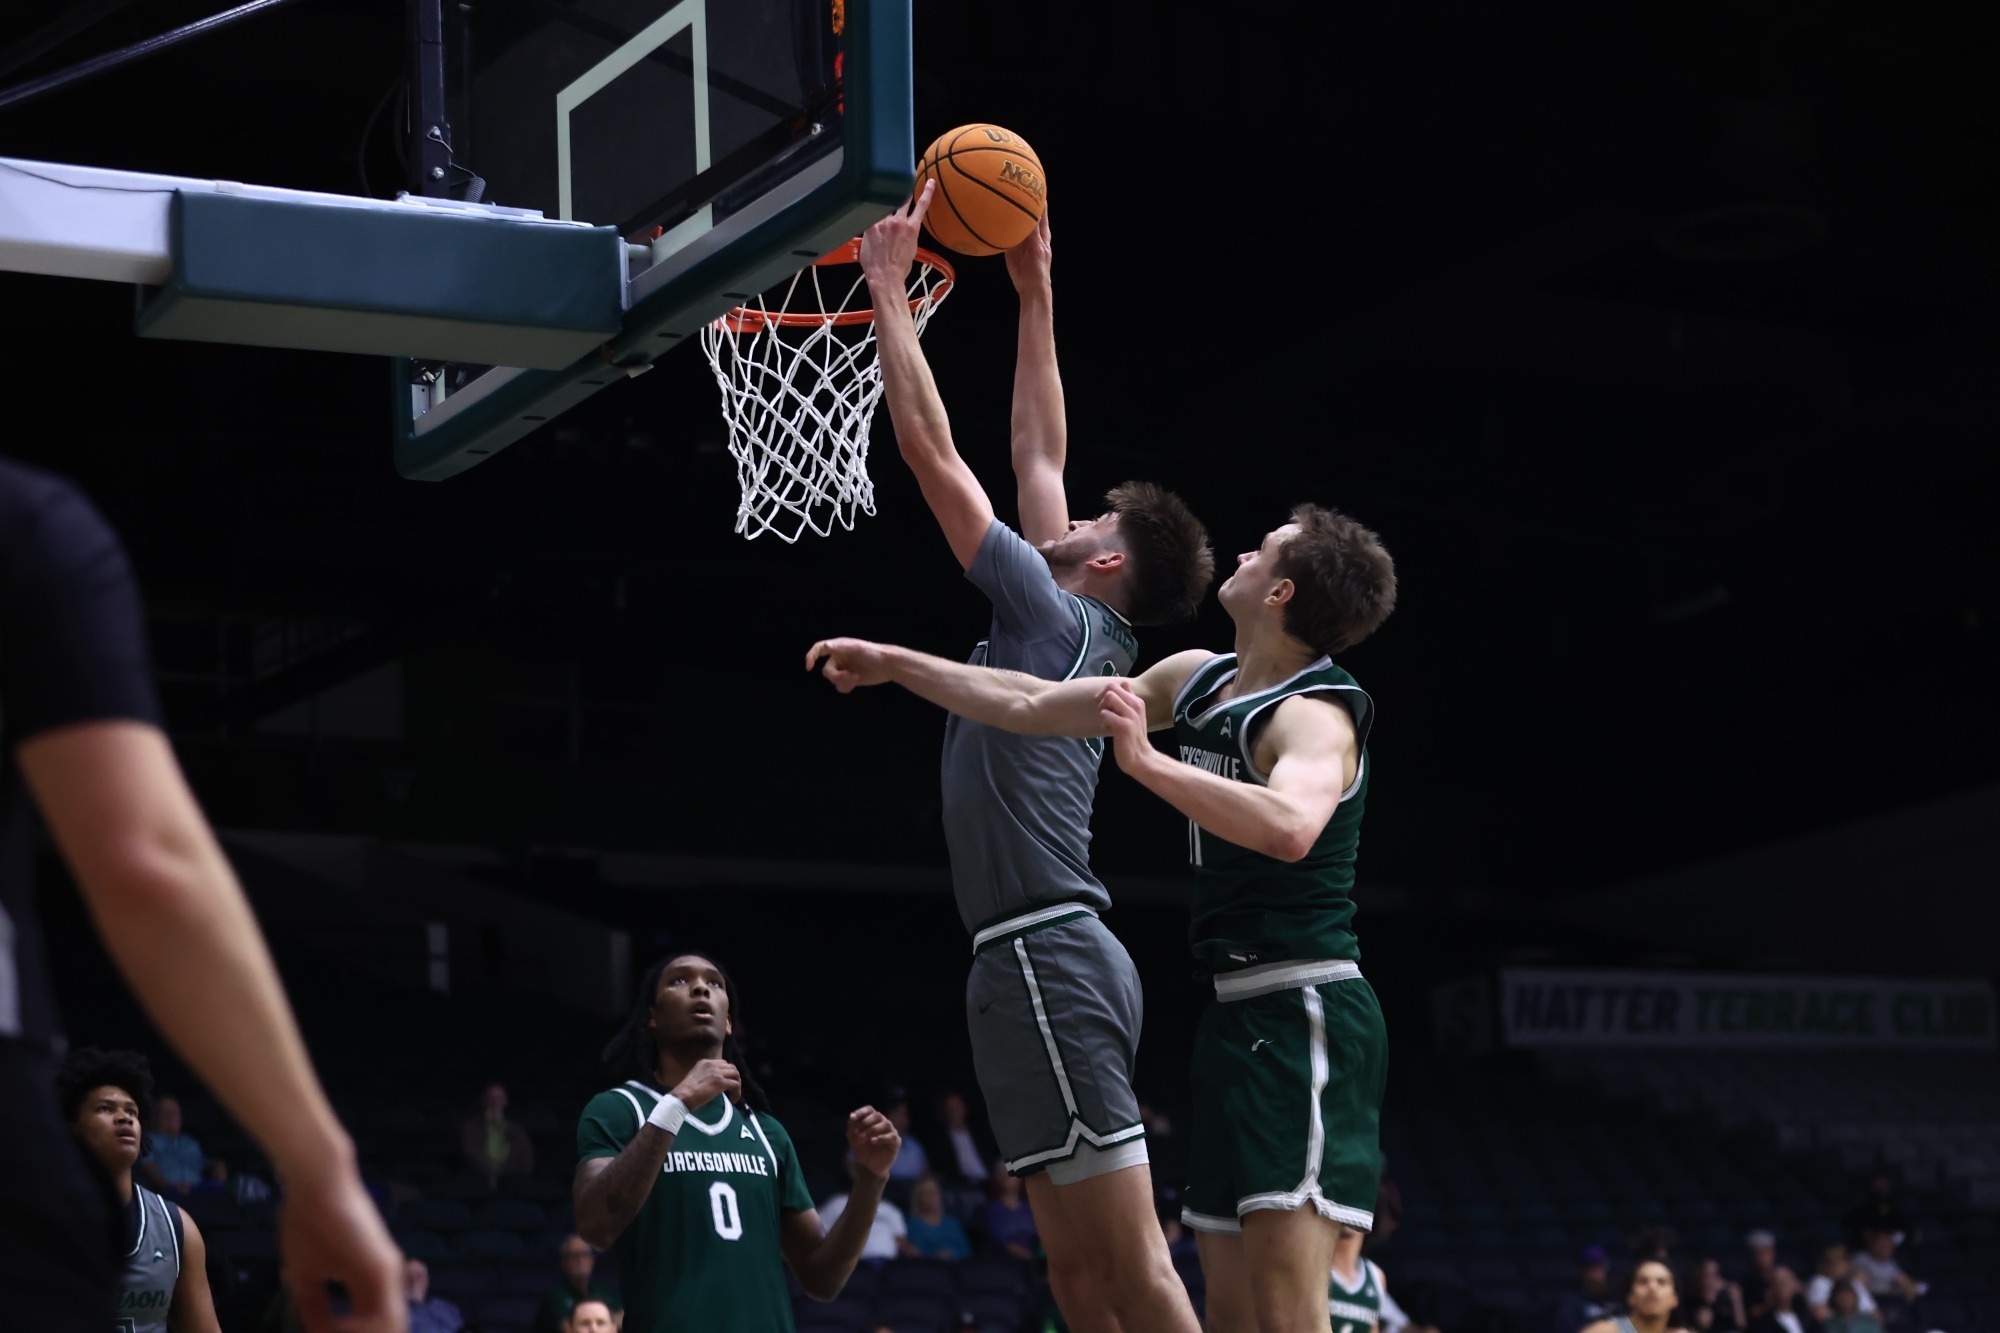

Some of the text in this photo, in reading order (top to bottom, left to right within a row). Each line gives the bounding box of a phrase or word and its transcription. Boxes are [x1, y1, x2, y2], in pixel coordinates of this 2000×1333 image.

[1179, 745, 1242, 782] CKSONVILLE
[1514, 984, 1991, 1037] HATTER TERRACE CLUB
[663, 1151, 768, 1177] JACKSONVILLE
[708, 1181, 743, 1241] 0
[117, 1286, 168, 1309] tson
